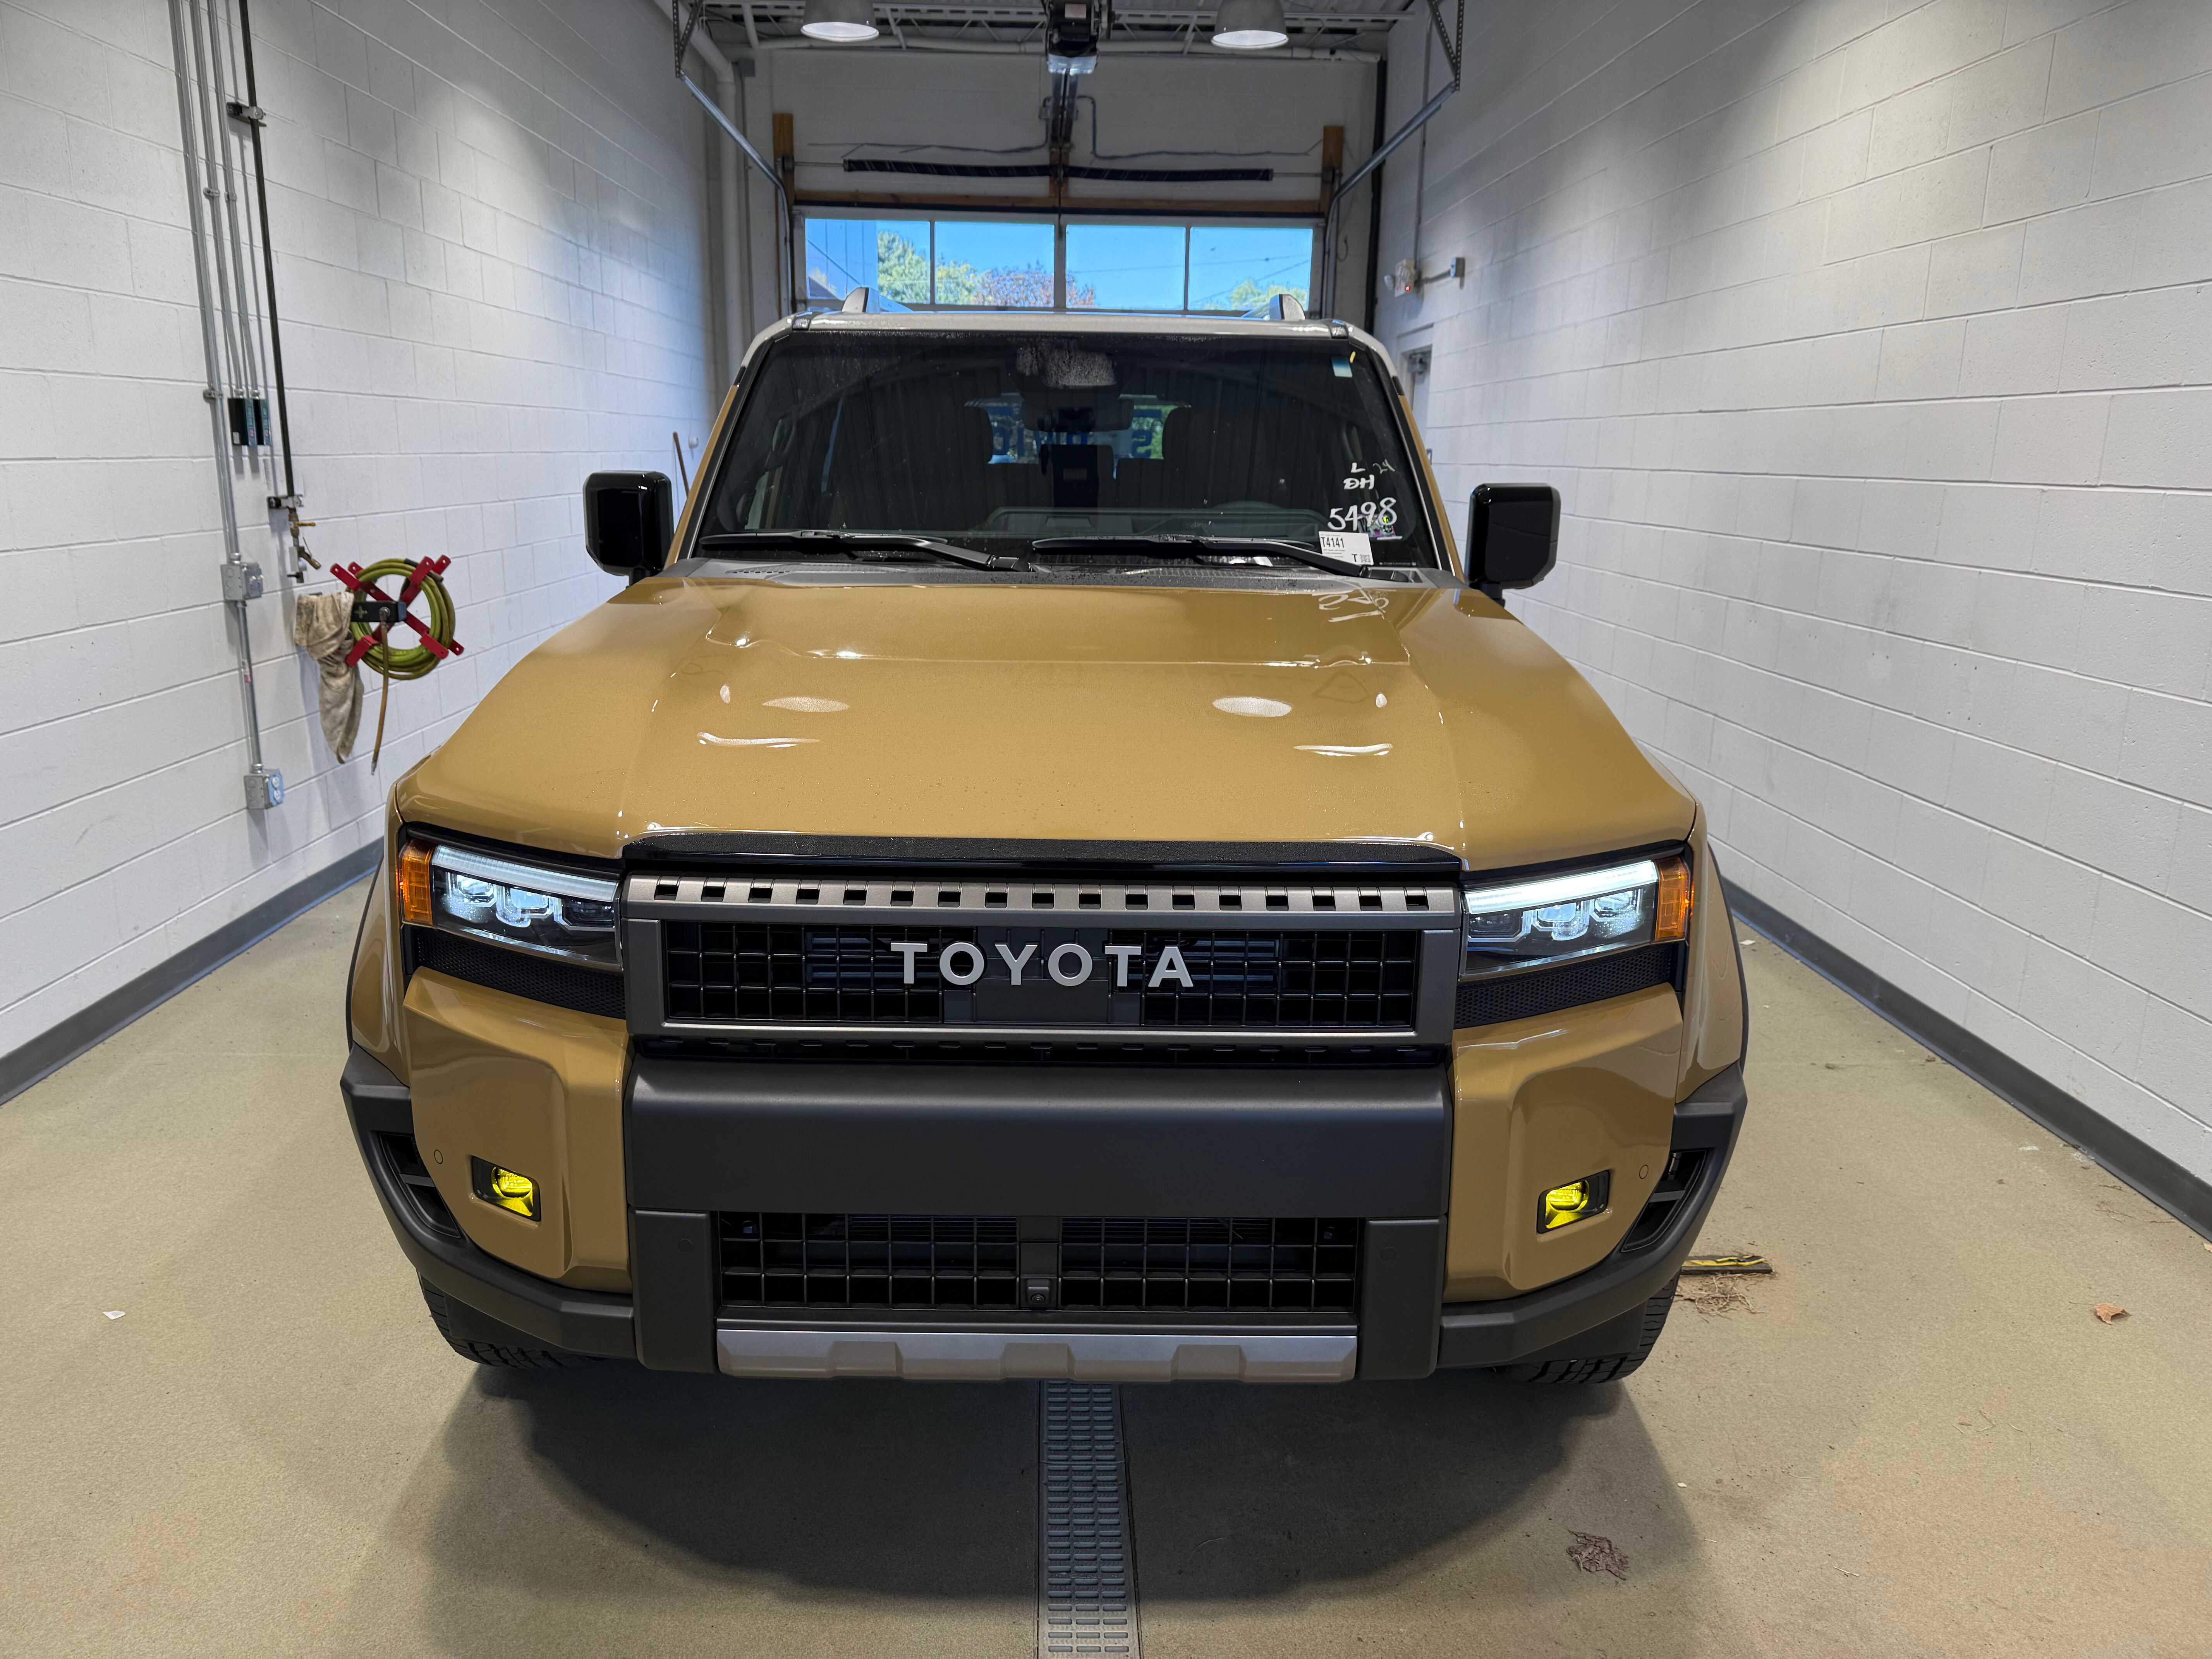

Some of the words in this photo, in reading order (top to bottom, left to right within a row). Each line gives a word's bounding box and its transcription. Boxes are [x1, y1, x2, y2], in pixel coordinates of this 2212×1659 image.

[1328, 497, 1397, 531] 5498
[1321, 537, 1344, 548] T4141
[1351, 553, 1357, 562] T
[891, 942, 1194, 987] TOYOTA
